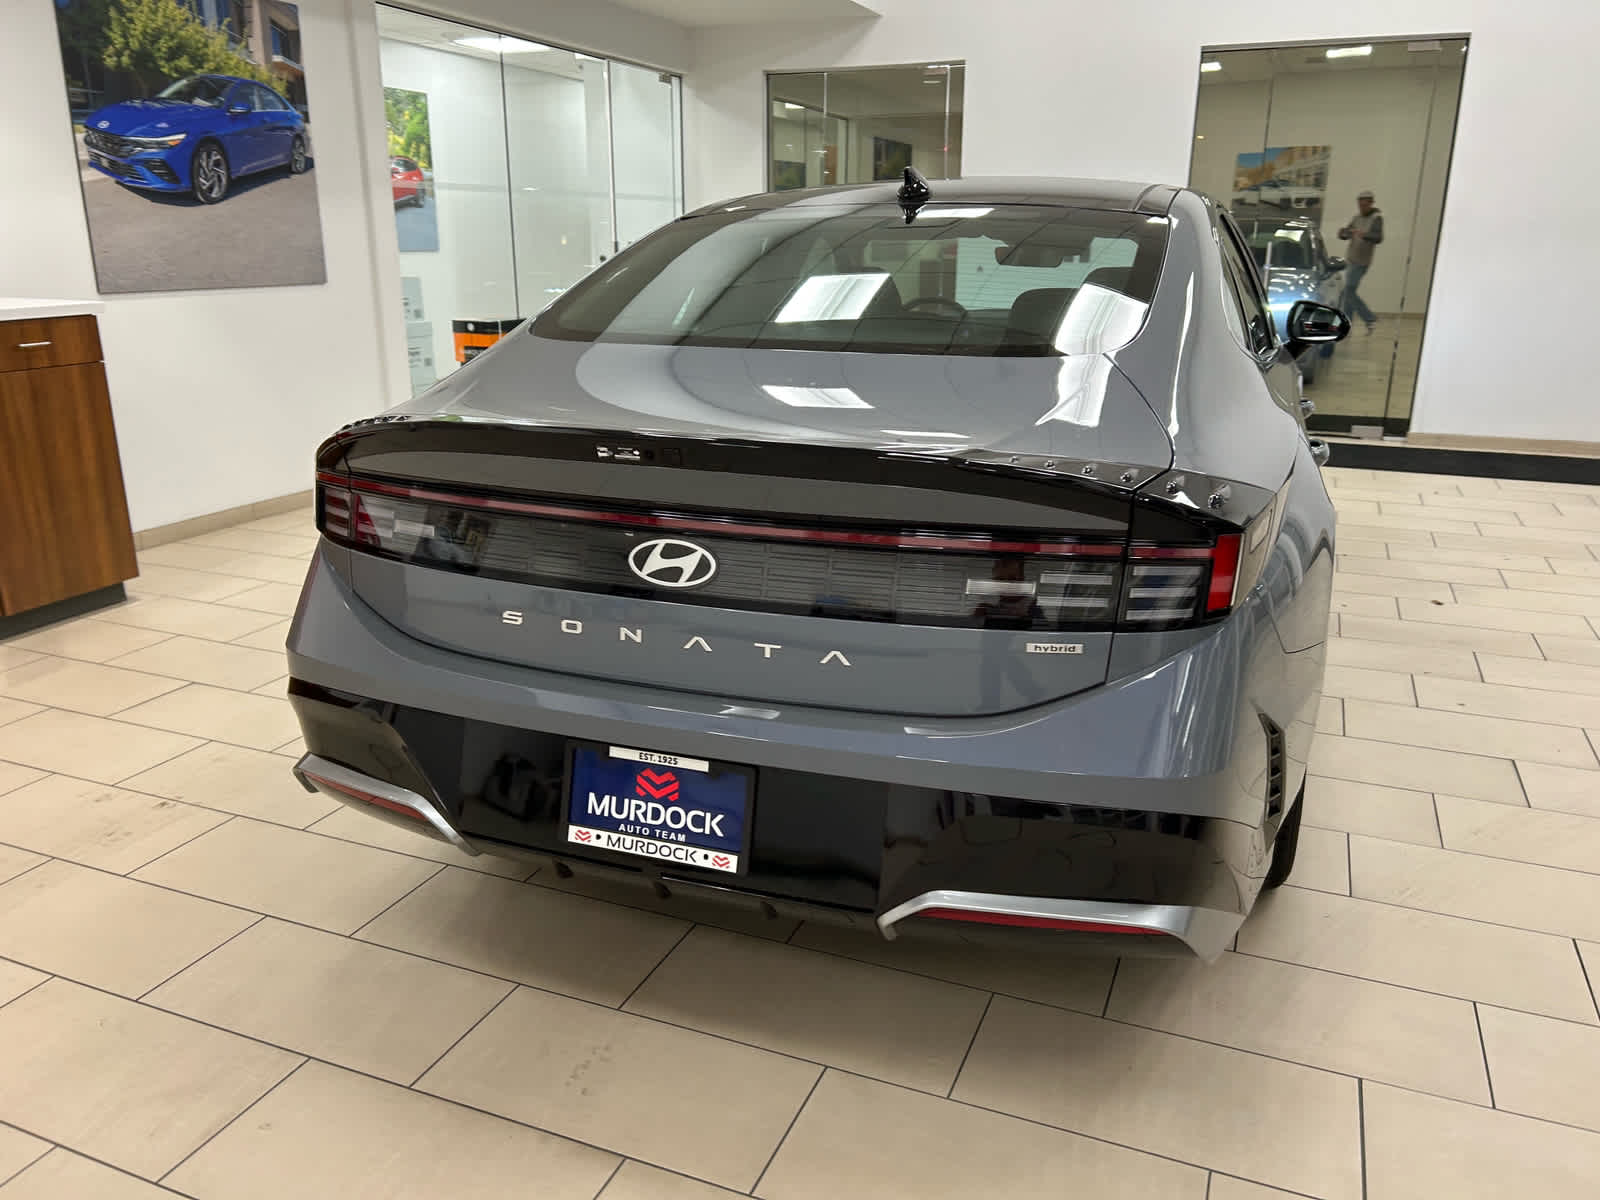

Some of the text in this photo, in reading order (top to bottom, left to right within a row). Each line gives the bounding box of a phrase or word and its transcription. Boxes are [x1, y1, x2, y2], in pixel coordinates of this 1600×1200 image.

[502, 610, 851, 667] SONATA
[1034, 644, 1076, 653] hybrid
[658, 755, 678, 765] 1925
[587, 791, 725, 837] MURDOCK
[618, 823, 686, 842] AUTO TEAM
[606, 834, 697, 863] MURDOCK
